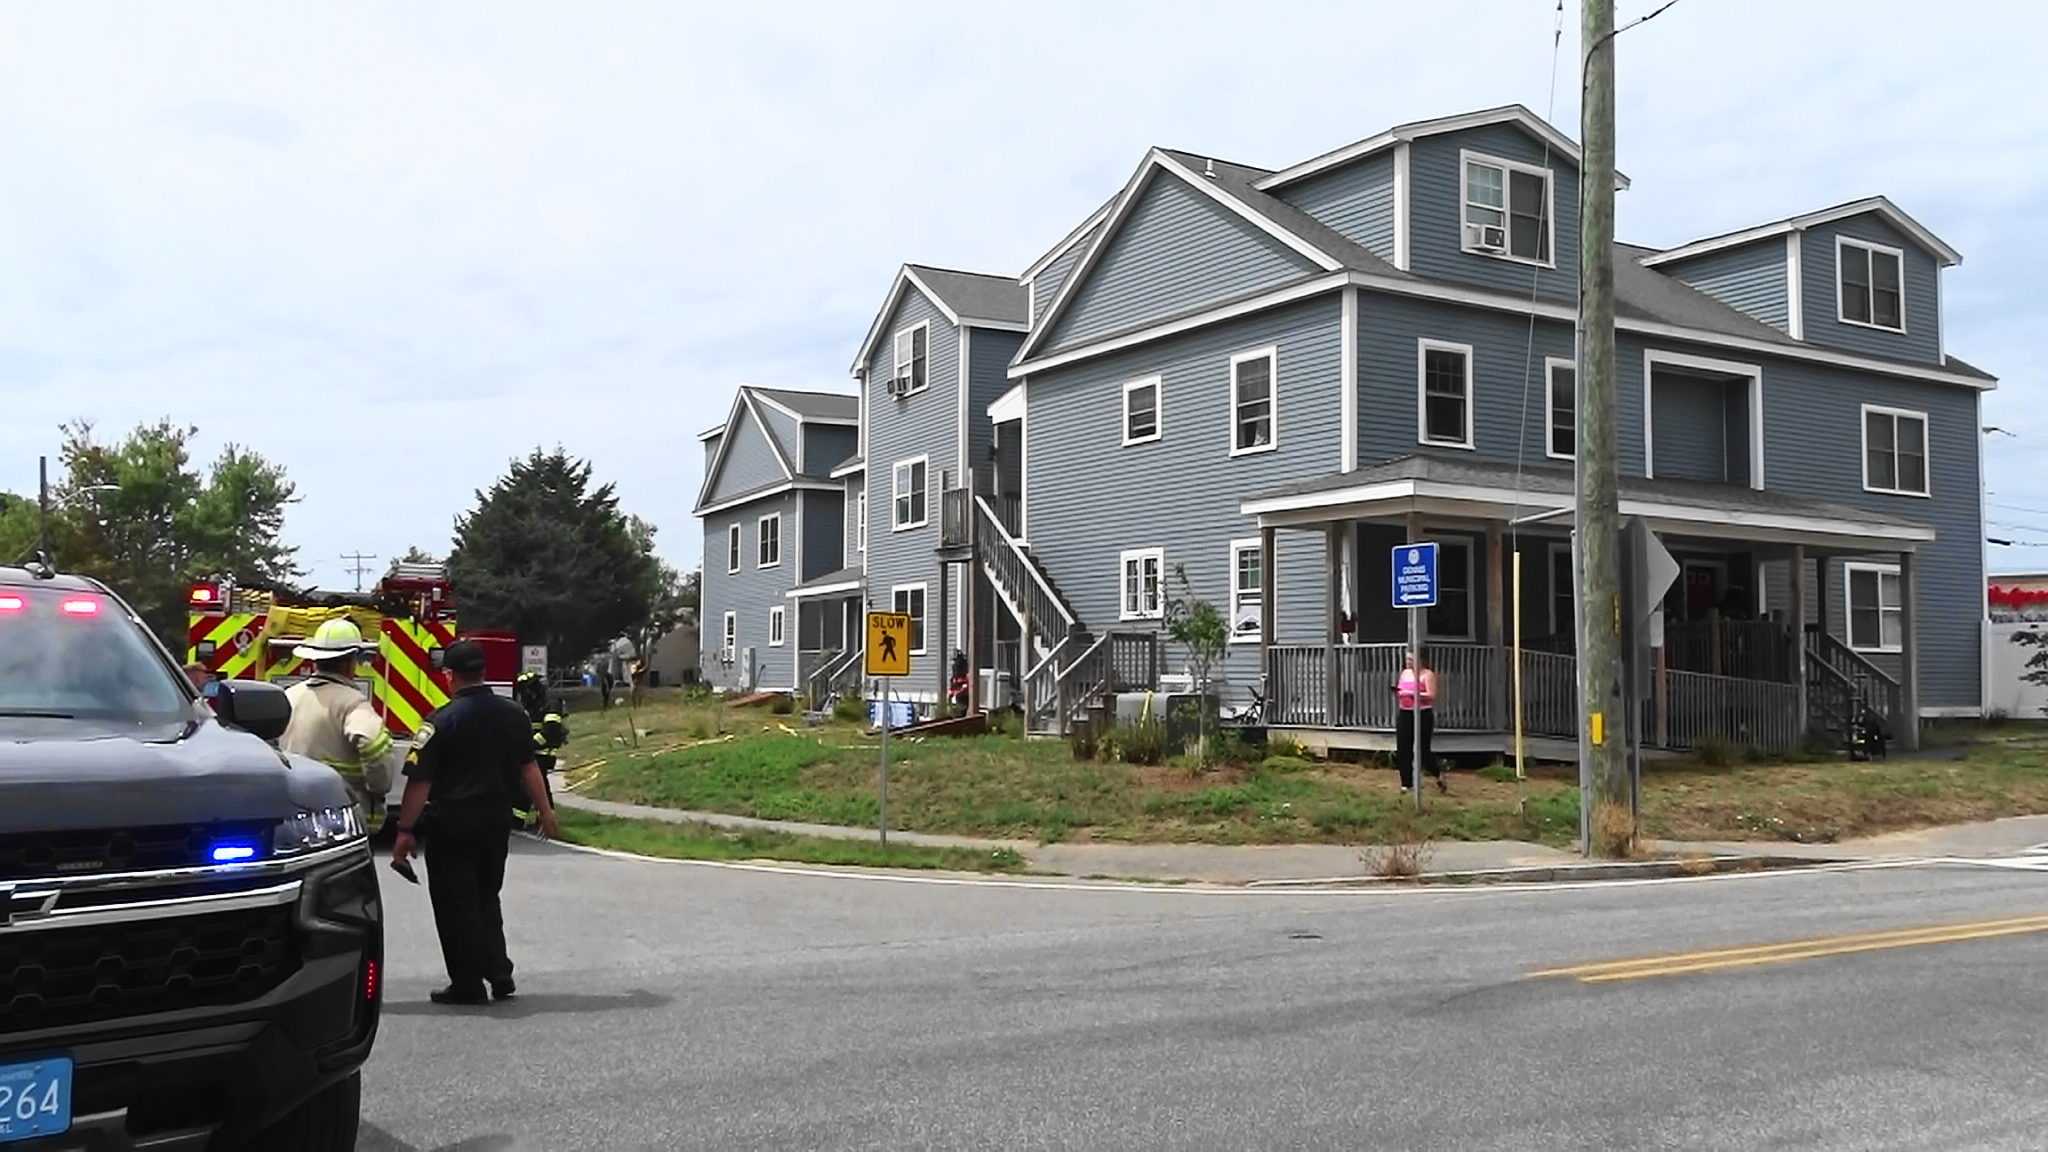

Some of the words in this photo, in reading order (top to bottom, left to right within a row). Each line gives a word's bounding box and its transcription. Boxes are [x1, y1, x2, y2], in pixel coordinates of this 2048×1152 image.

[1397, 574, 1431, 585] MUNICIPAL
[1400, 583, 1429, 593] PARKING
[872, 616, 905, 629] SLOW
